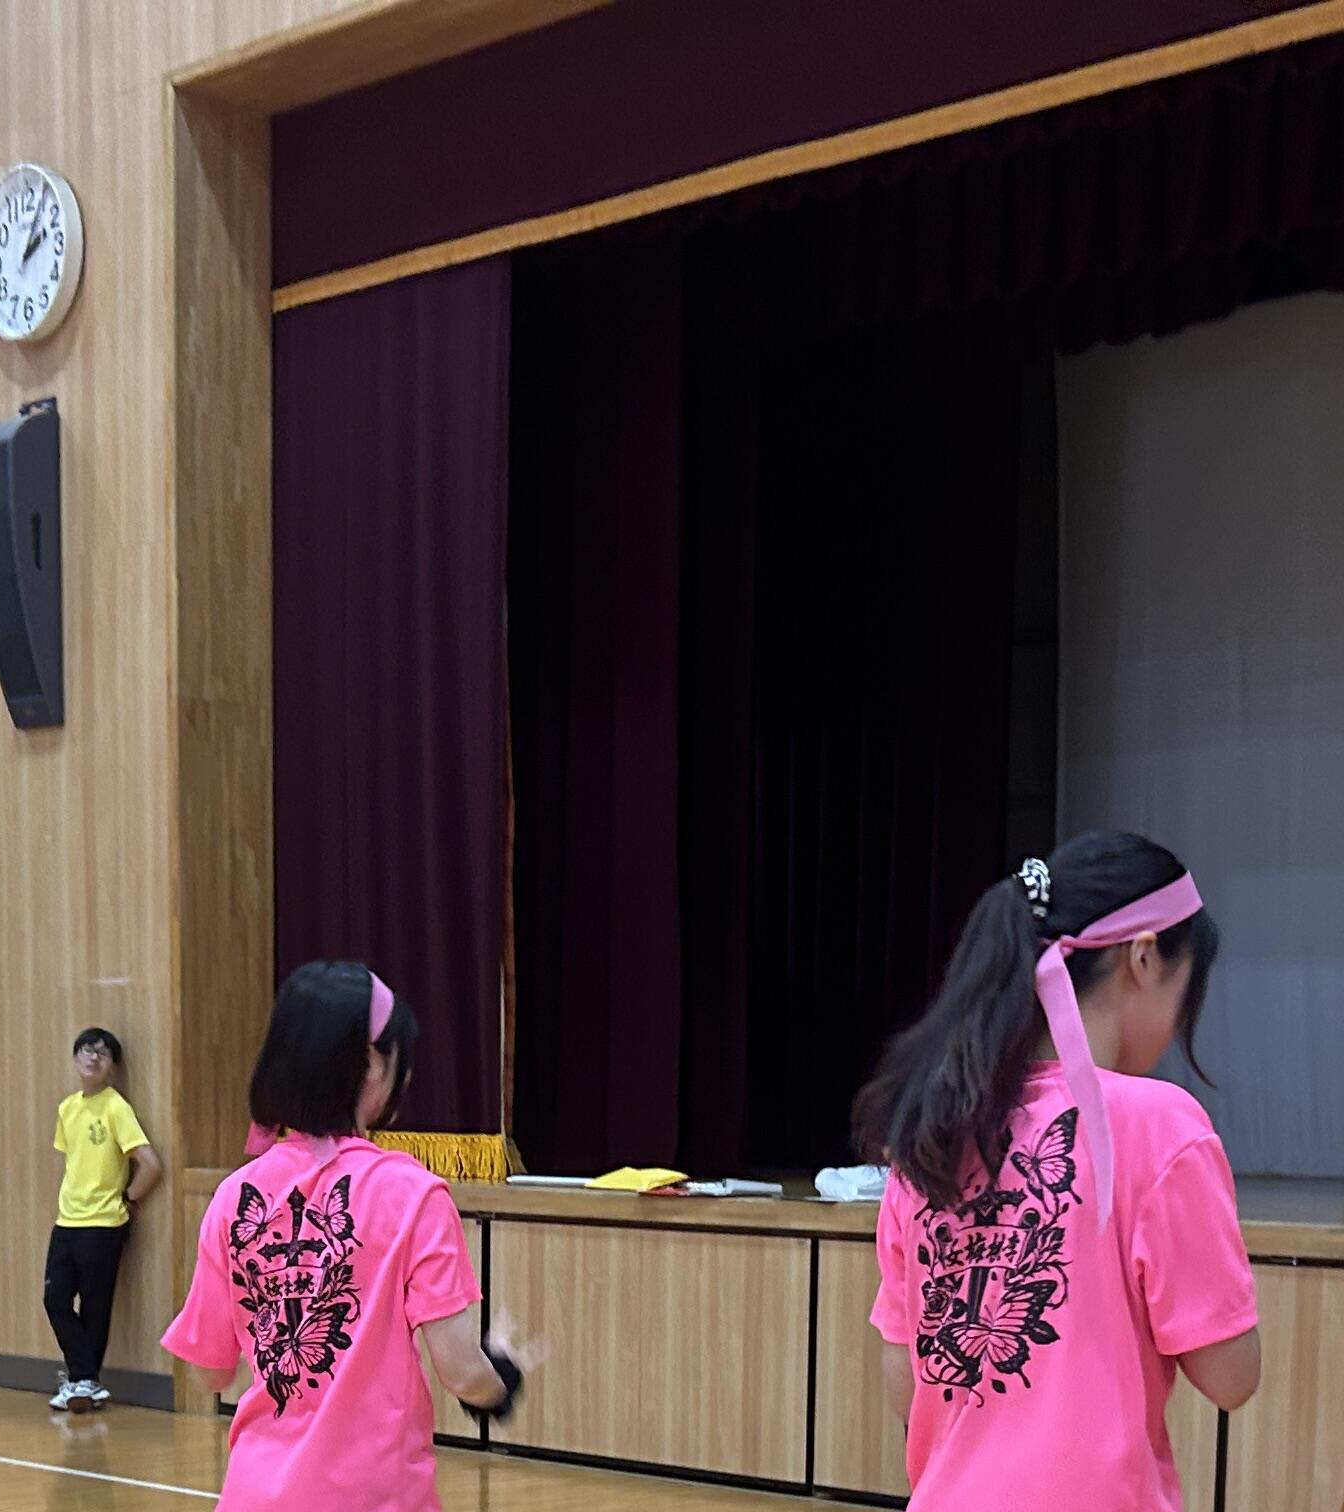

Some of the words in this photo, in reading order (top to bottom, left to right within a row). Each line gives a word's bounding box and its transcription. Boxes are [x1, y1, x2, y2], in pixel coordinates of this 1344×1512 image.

[5, 195, 19, 223] 11
[21, 187, 35, 214] 12
[50, 203, 60, 229] 2
[54, 230, 64, 256] 3
[50, 260, 59, 282] 4
[9, 294, 20, 319] 7
[23, 296, 34, 321] 6
[38, 283, 49, 309] 5
